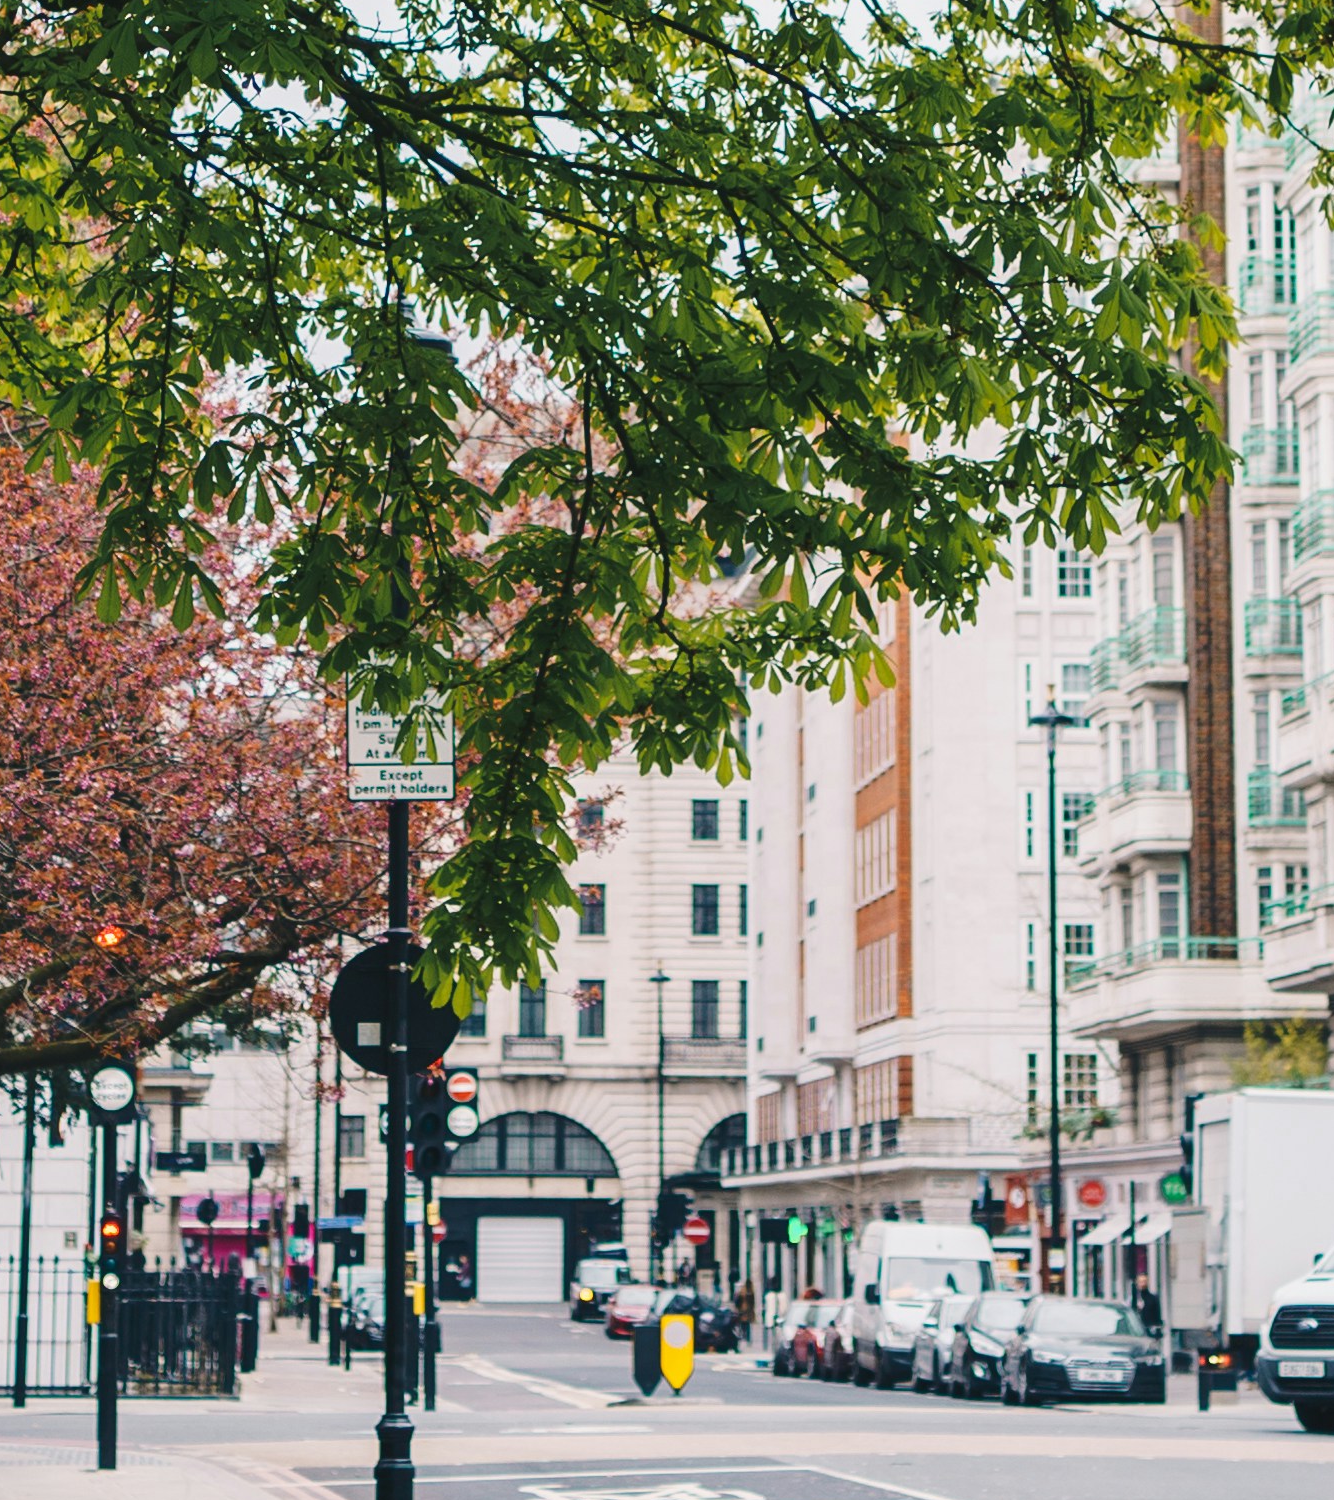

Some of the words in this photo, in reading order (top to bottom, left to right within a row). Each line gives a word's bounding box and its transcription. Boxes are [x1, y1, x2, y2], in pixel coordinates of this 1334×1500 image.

[378, 733, 423, 746] Suy
[365, 748, 379, 758] At
[379, 769, 423, 782] Except
[354, 784, 395, 795] permit
[400, 783, 448, 793] holders
